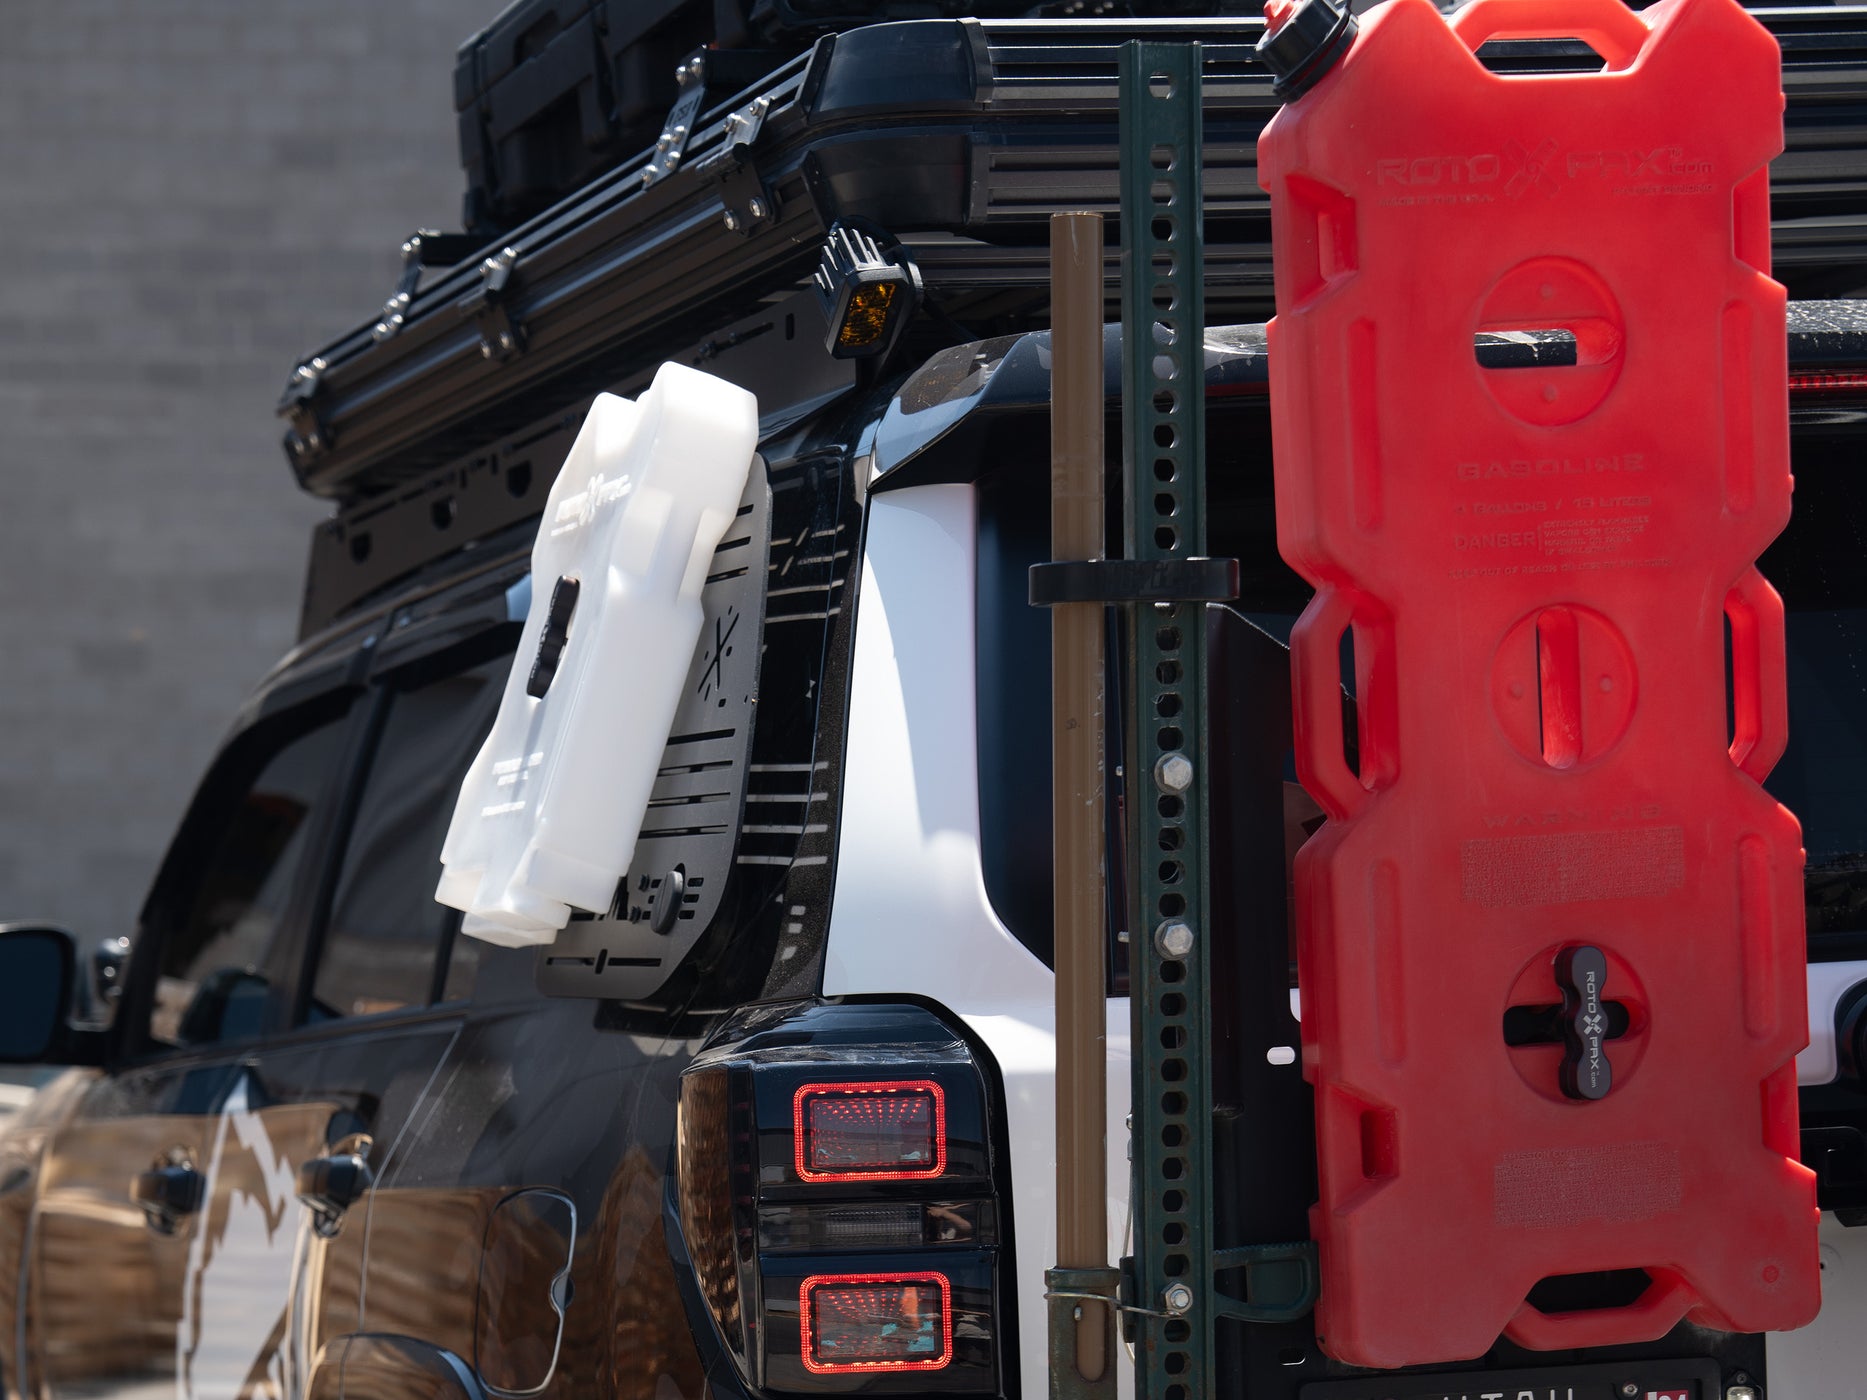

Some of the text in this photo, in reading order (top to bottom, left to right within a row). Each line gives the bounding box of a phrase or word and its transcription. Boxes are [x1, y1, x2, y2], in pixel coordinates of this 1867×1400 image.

[1377, 153, 1500, 186] ROTO
[1455, 453, 1646, 481] GASOLINE
[1454, 531, 1536, 552] DANGER
[1586, 971, 1597, 1014] ROTO
[1589, 1036, 1600, 1070] PAX
